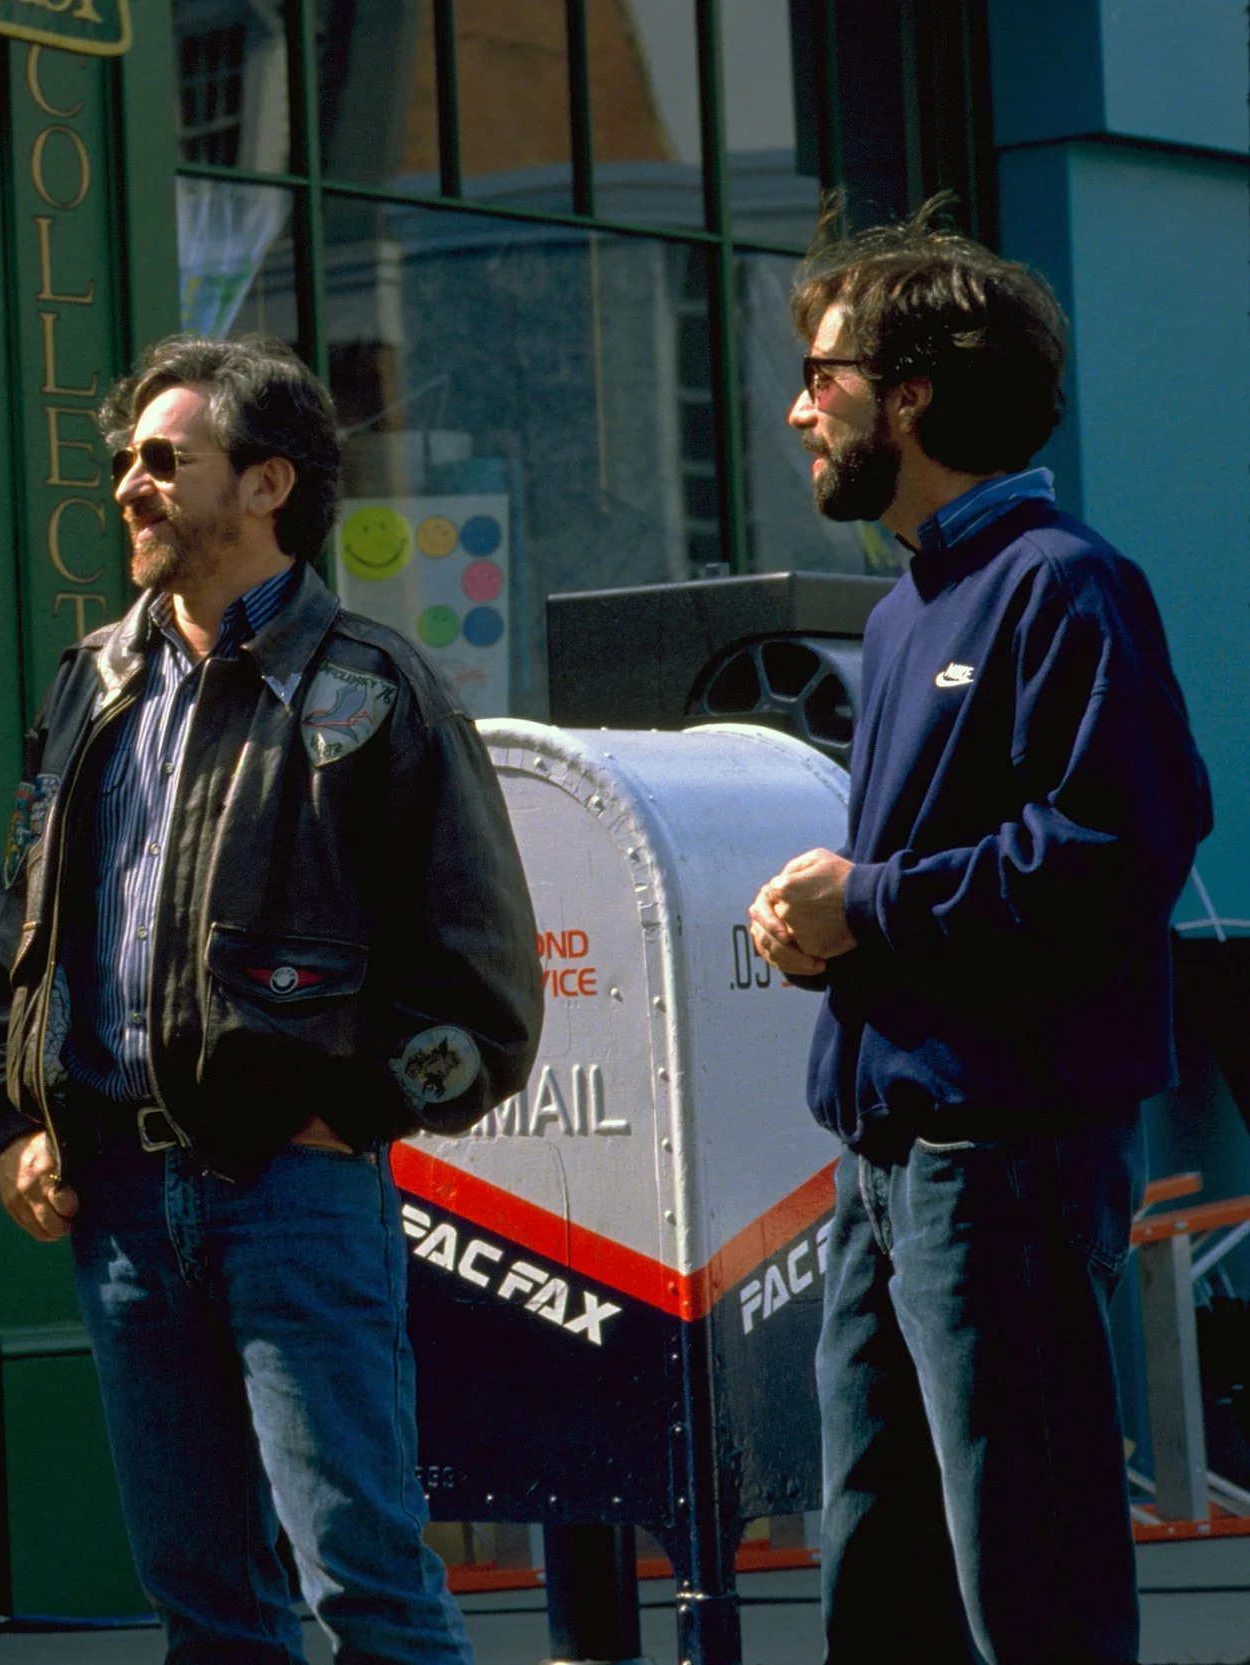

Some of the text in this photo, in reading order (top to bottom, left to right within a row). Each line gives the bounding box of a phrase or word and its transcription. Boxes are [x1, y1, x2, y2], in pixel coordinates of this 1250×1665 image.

[944, 662, 976, 681] NIKE
[497, 1260, 622, 1346] FAX
[739, 1239, 812, 1335] PAC
